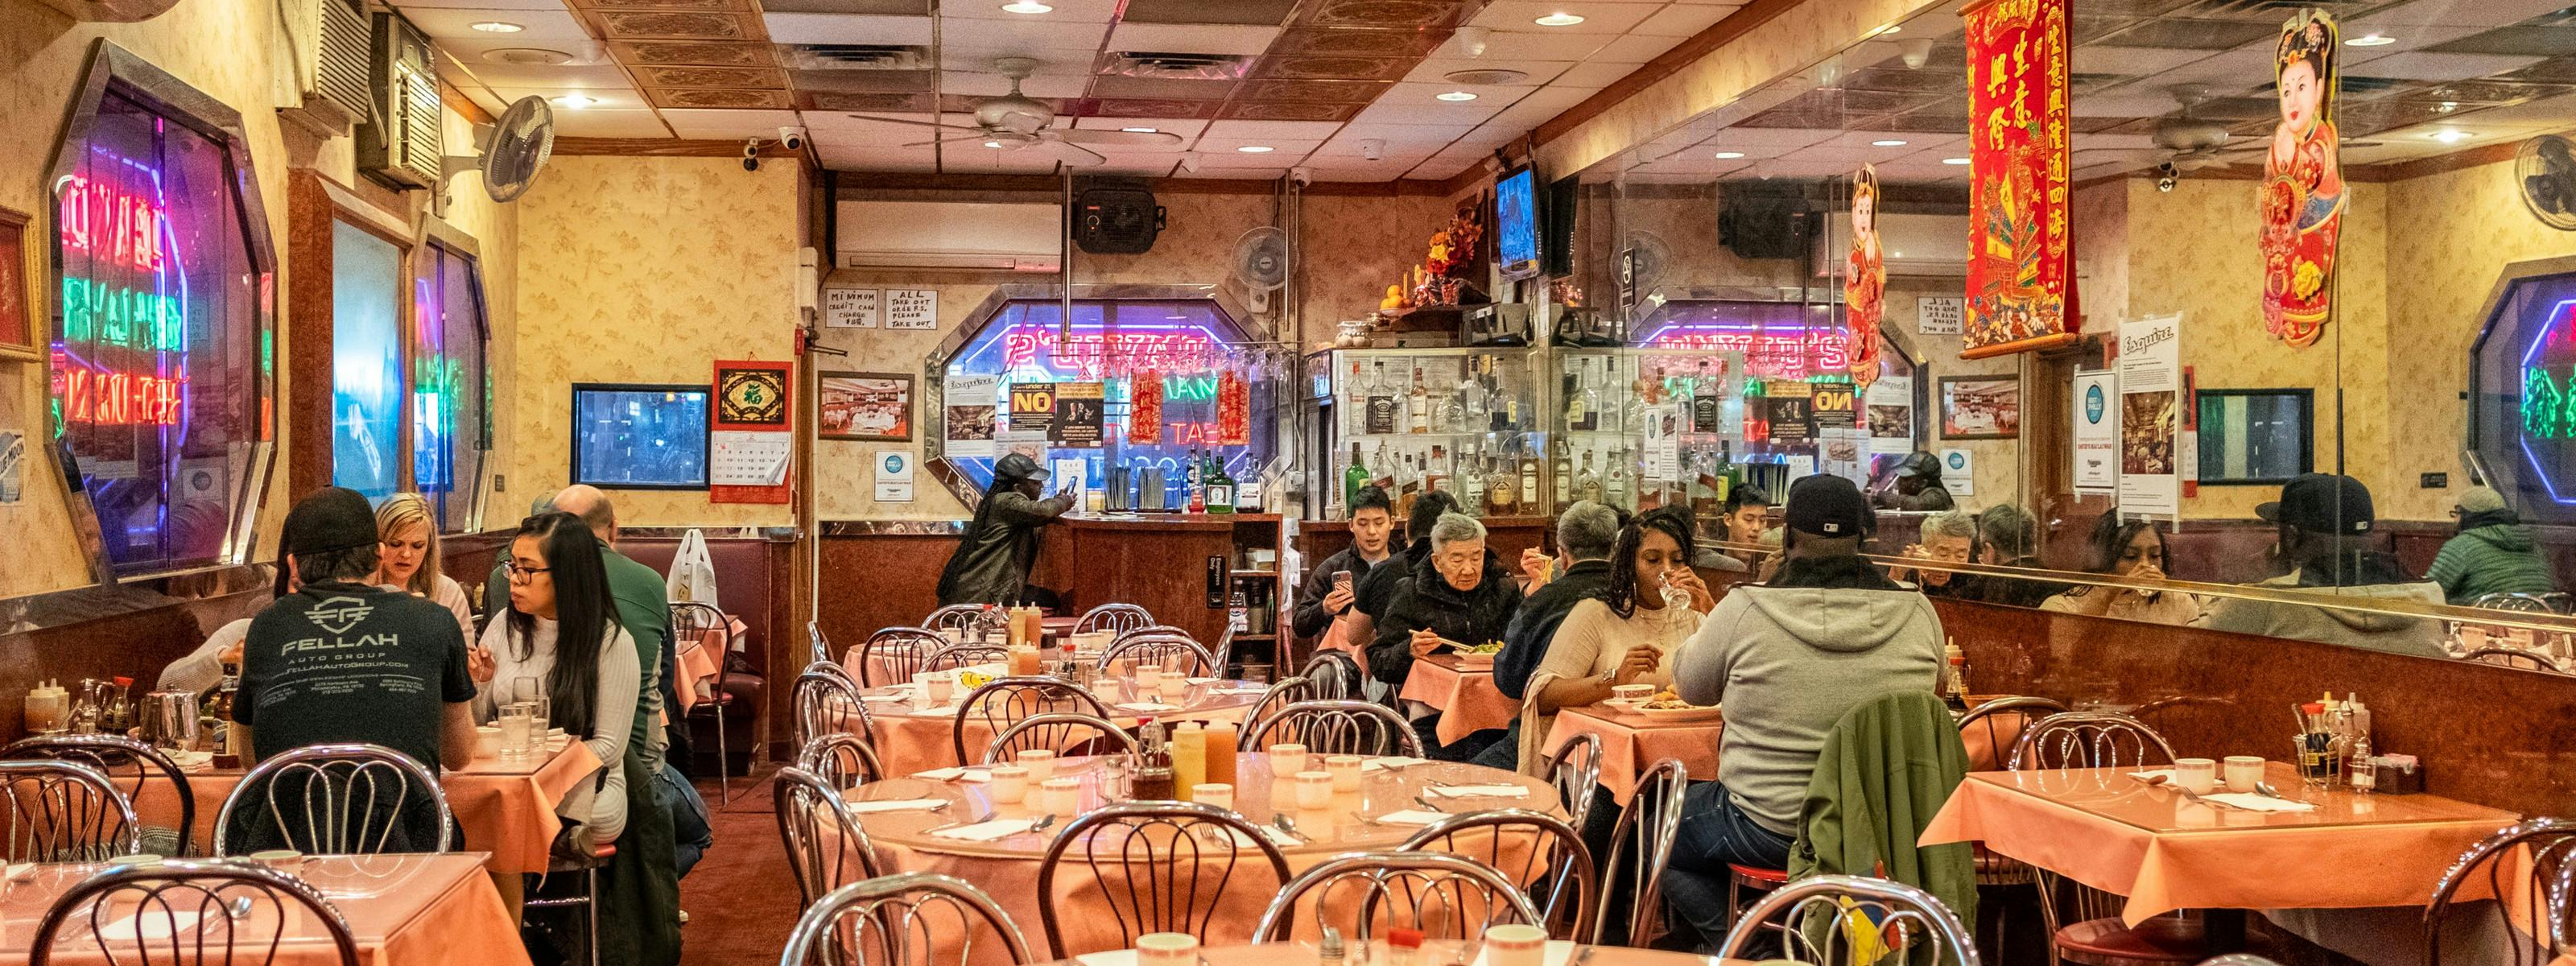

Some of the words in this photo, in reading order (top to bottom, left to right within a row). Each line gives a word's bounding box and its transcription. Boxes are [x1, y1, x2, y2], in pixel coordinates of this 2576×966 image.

[2012, 31, 2033, 130] 生意
[1987, 51, 2011, 152] 興隆
[899, 290, 925, 299] ALL
[2123, 326, 2174, 356] Esquire
[743, 383, 763, 405] 福
[1013, 391, 1051, 413] NO
[282, 633, 398, 657] FELLAH
[287, 654, 327, 665] AUTO
[334, 652, 386, 661] GROUP
